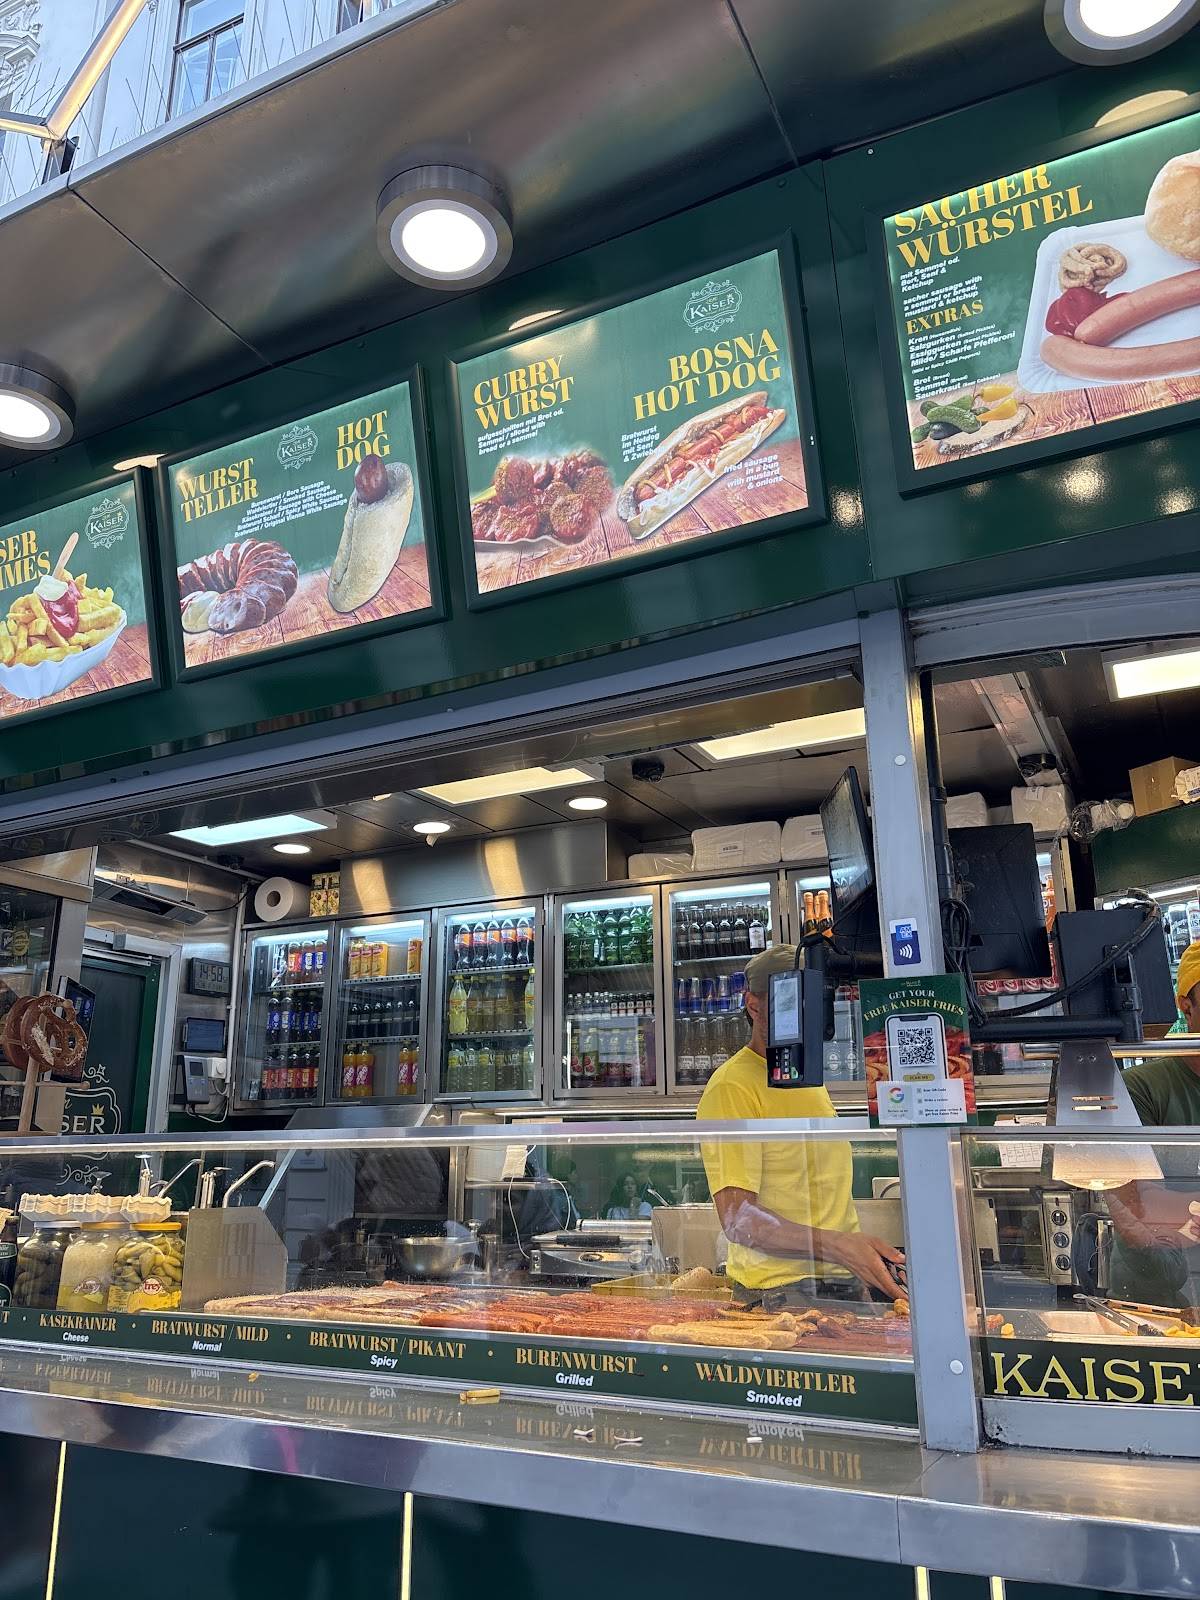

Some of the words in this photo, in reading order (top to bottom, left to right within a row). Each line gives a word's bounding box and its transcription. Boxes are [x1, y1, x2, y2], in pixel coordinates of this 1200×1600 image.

[895, 163, 1051, 237] SACHER
[897, 185, 1093, 268] WÜRSTEL
[900, 270, 912, 279] mit
[914, 260, 946, 275] Semmel
[948, 257, 960, 265] od.
[920, 269, 938, 280] Senf
[940, 267, 946, 275] &
[902, 278, 933, 292] Ketchup
[904, 293, 929, 304] sacher
[931, 283, 962, 296] sausage
[965, 276, 982, 286] with
[905, 302, 936, 317] mustard
[946, 291, 978, 305] ketchup
[911, 294, 940, 308] semmel
[952, 285, 978, 296] bread,
[689, 297, 735, 319] KAISER
[906, 300, 983, 335] EXTRAS
[909, 336, 928, 345] Kren
[909, 336, 956, 352] Salzgurken
[910, 342, 960, 359] Essiggurken
[911, 353, 936, 366] Milde/
[940, 345, 972, 358] Scharfe
[974, 332, 1016, 349] Pfefferoni
[669, 329, 779, 382] BOSNA
[473, 355, 563, 405] CURRY
[632, 376, 700, 420] HOT
[706, 354, 781, 398] DOG
[914, 376, 930, 386] Brot
[914, 379, 948, 393] Semmel
[915, 382, 960, 400] Sauerkraut
[474, 376, 574, 430] WURST
[525, 417, 536, 425] mit
[537, 411, 551, 421] Brot
[553, 408, 563, 416] od.
[337, 411, 387, 447] HOT
[478, 434, 504, 447] Semmel
[510, 425, 529, 437] sliced
[531, 420, 545, 430] with
[621, 425, 656, 441] Bratwurst
[633, 434, 659, 445] Hotdog
[282, 440, 313, 457] KAISER
[336, 434, 391, 470] DOG
[478, 443, 497, 454] bread
[512, 429, 537, 443] semmel
[622, 446, 634, 455] mit
[636, 440, 653, 451] Senf
[723, 462, 741, 472] fried
[744, 454, 777, 467] sausage
[177, 458, 255, 501] WURST
[301, 480, 324, 491] Sausage
[727, 477, 744, 487] with
[746, 467, 779, 482] mustard
[755, 476, 782, 487] onions
[181, 479, 258, 522] TELLER
[278, 500, 301, 510] Sausage
[303, 495, 314, 503] with
[315, 489, 336, 498] Cheese
[283, 492, 305, 503] Smoked
[307, 485, 330, 495] Sausage
[285, 507, 300, 515] Spicy
[302, 501, 317, 509] White
[319, 493, 342, 504] Sausage
[264, 517, 285, 527] Original
[287, 512, 304, 520] Vienna
[306, 506, 321, 514] White
[323, 498, 347, 509] Sausage
[90, 515, 123, 534] KAISER
[0, 551, 50, 590] MES
[200, 963, 223, 982] 14:58
[889, 991, 906, 1000] GET
[909, 989, 935, 997] YOUR
[863, 1005, 889, 1021] FREE
[890, 999, 931, 1011] KAISER
[933, 1000, 965, 1016] FRIES
[40, 1313, 117, 1331] KASEKRAINER
[151, 1320, 228, 1339] BRATWURST
[235, 1326, 269, 1342] MILD
[62, 1332, 90, 1342] Cheese
[192, 1340, 222, 1352] Normal
[309, 1331, 399, 1354] BRATWURST
[407, 1339, 467, 1359] PIKANT
[370, 1355, 398, 1369] Spicy
[515, 1348, 637, 1374] BURENWURST
[555, 1373, 594, 1387] Grilled
[695, 1362, 857, 1395] WALDVIERTLER
[991, 1352, 1200, 1406] KAISE
[746, 1390, 803, 1408] Smoked
